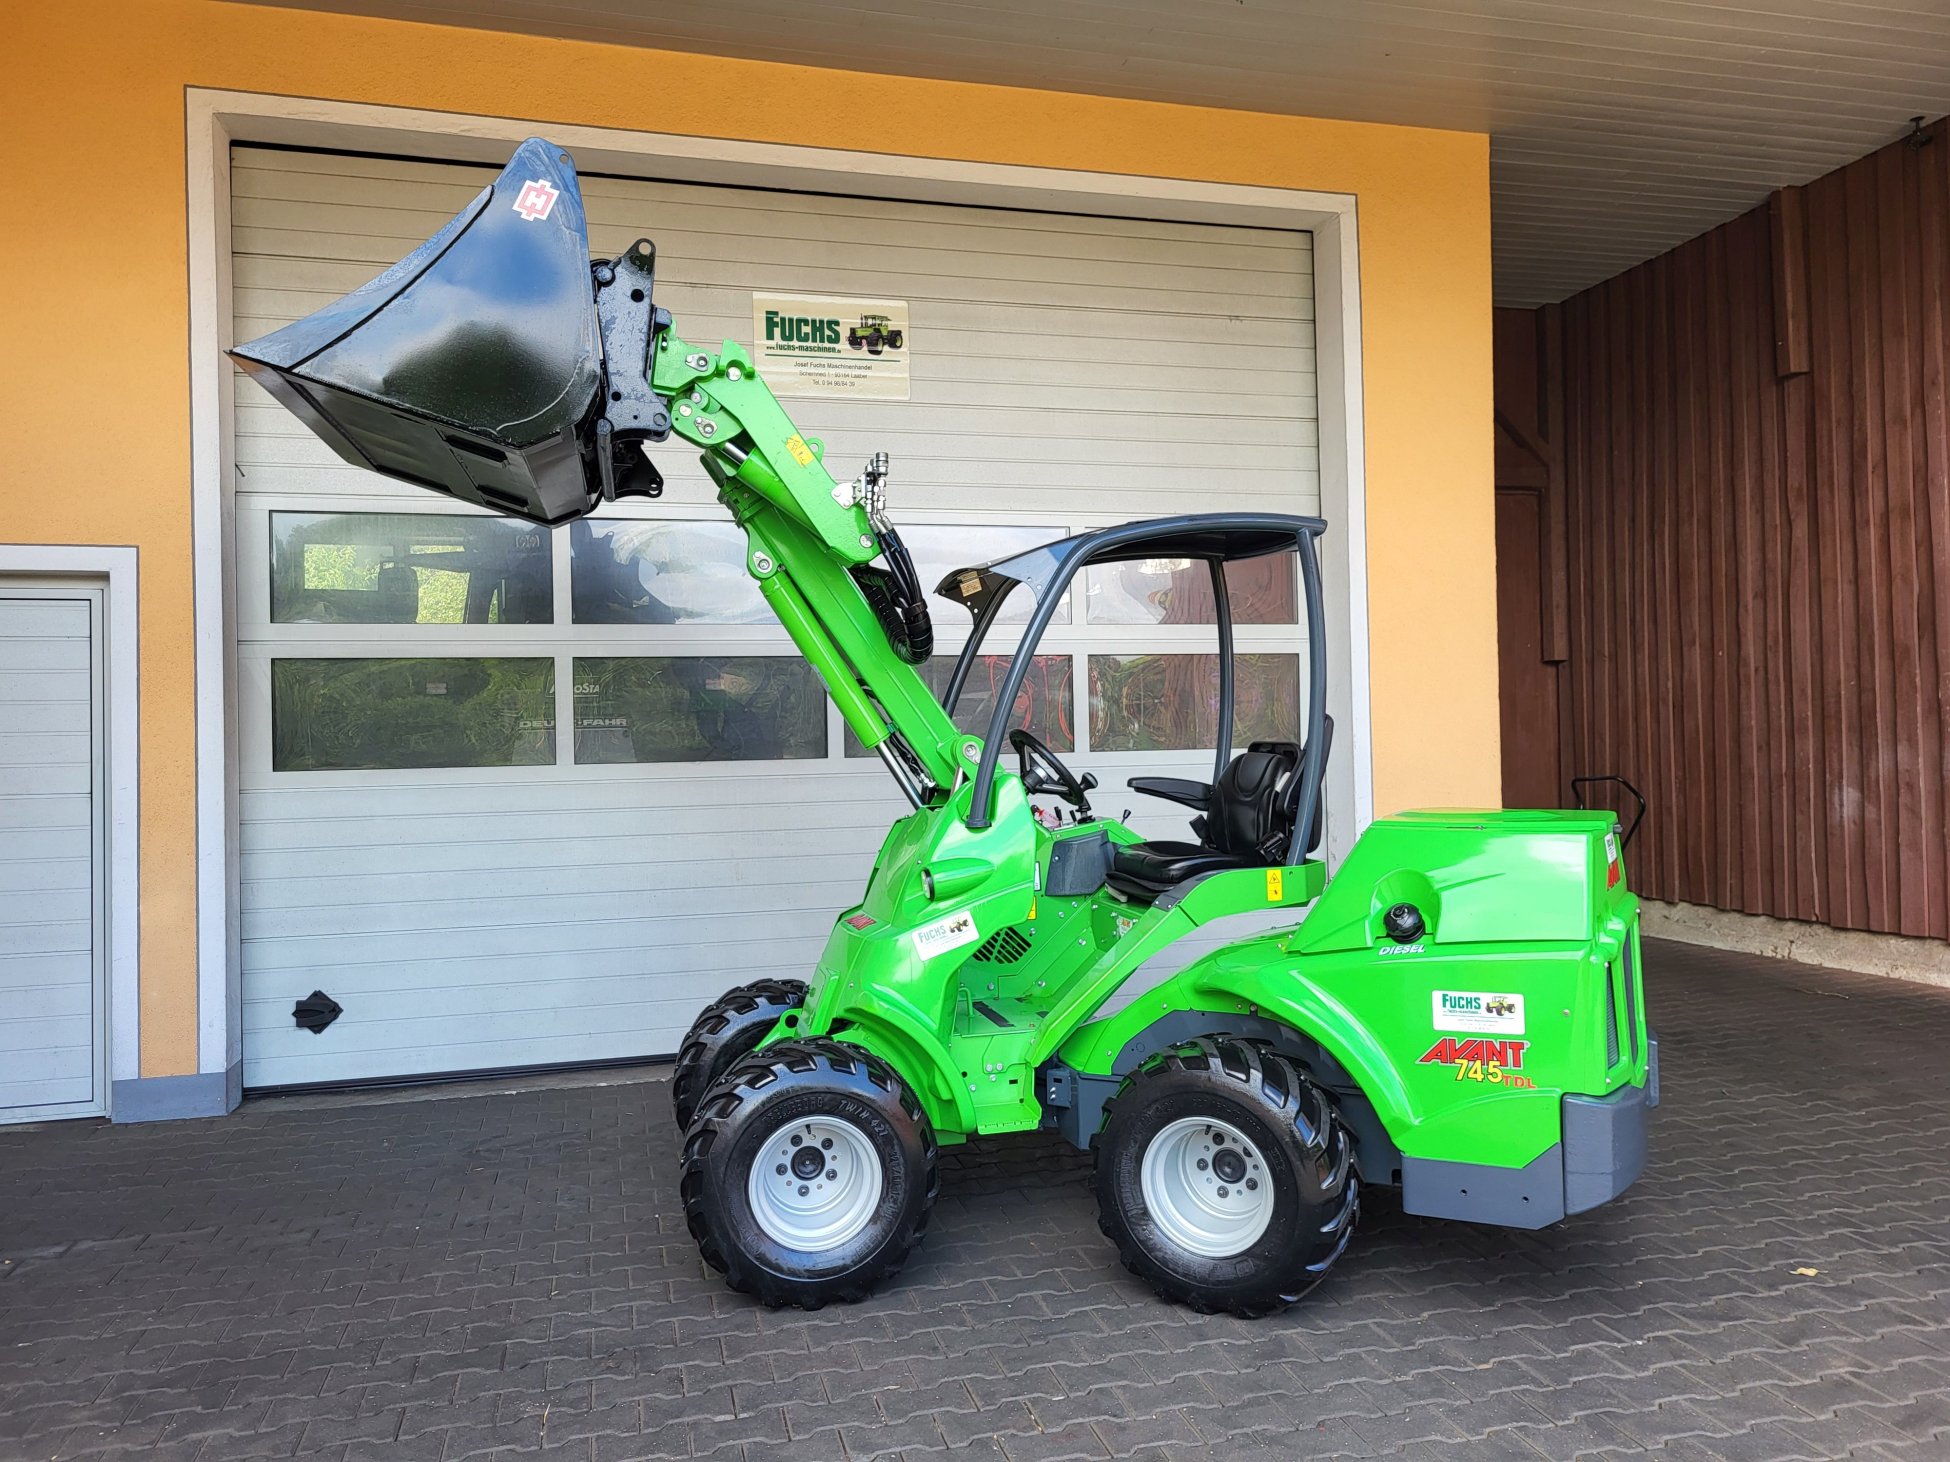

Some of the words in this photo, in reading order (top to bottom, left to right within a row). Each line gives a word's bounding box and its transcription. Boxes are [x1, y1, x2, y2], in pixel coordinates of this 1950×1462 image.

[765, 310, 841, 344] FUCHS
[826, 363, 873, 371] Maschinenhandel
[918, 926, 948, 943] FUCHS
[1378, 944, 1426, 956] DIESEL
[1442, 993, 1481, 1010] FUCHS
[1419, 1038, 1525, 1068] AVANT
[1454, 1058, 1504, 1084] 745
[1503, 1074, 1537, 1089] TDL
[838, 1099, 870, 1120] TWIN
